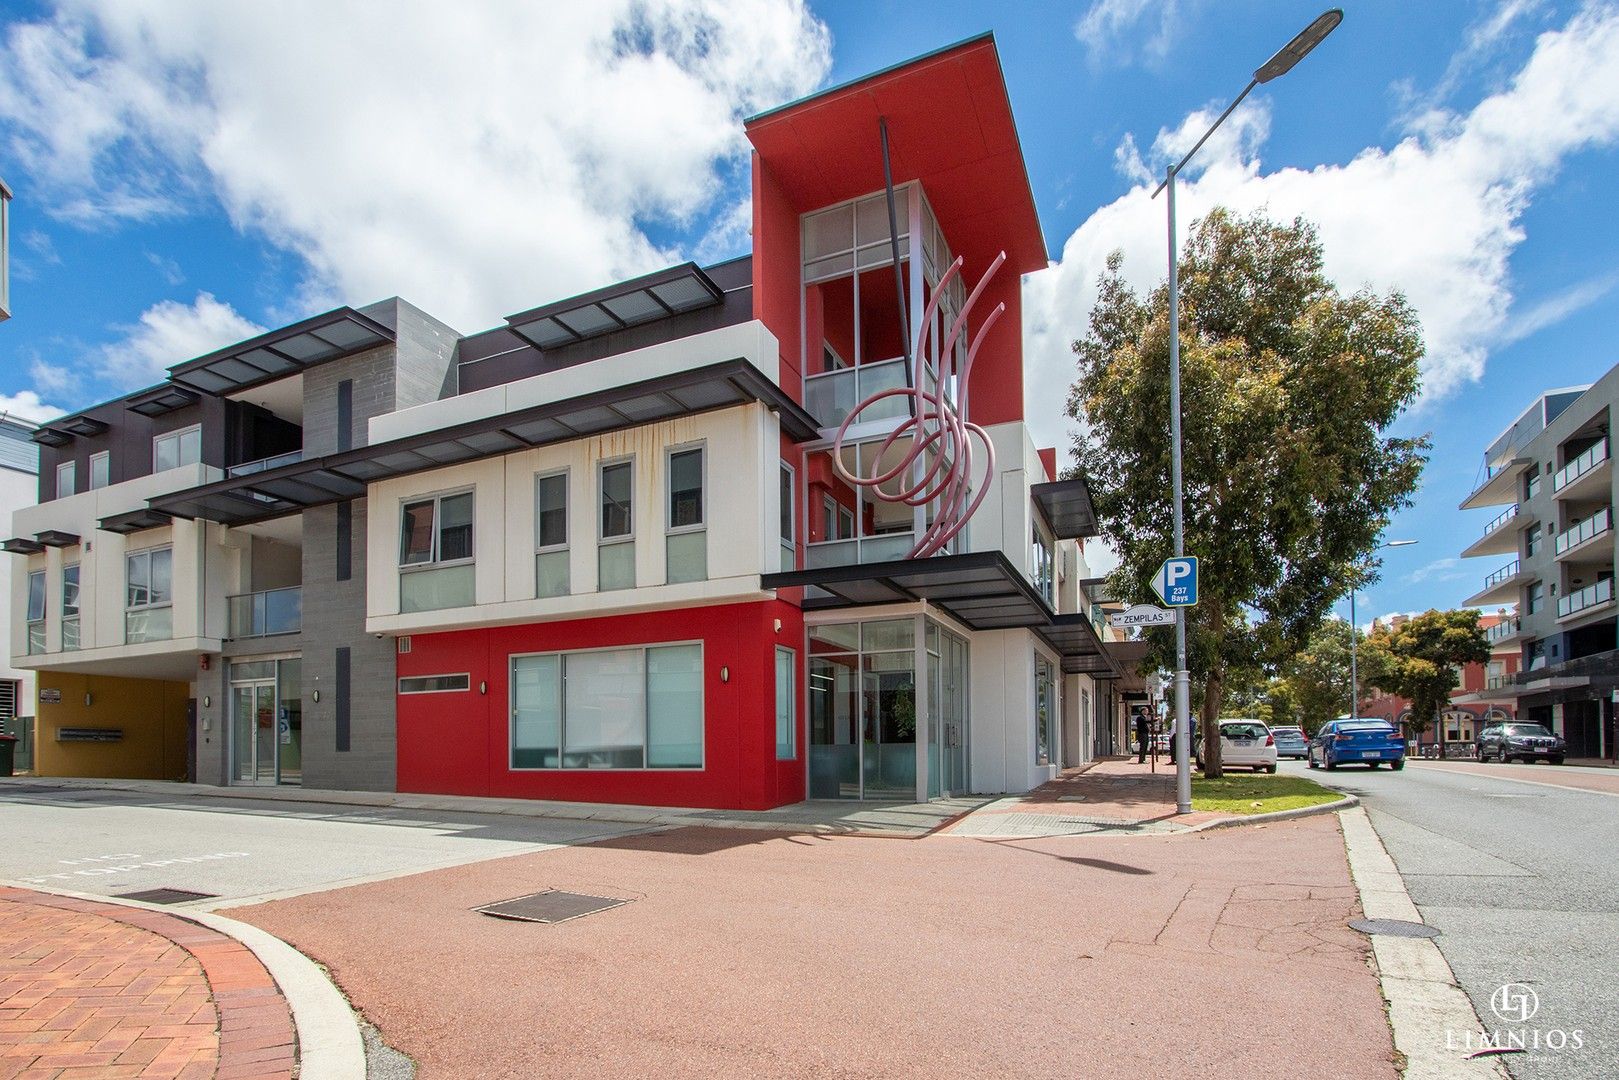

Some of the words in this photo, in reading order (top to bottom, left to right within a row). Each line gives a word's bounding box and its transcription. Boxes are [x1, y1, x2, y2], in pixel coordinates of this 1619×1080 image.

[1168, 561, 1191, 586] P
[1173, 587, 1187, 595] 237
[1171, 595, 1188, 603] Bays
[1124, 613, 1164, 624] ZEMPILAS
